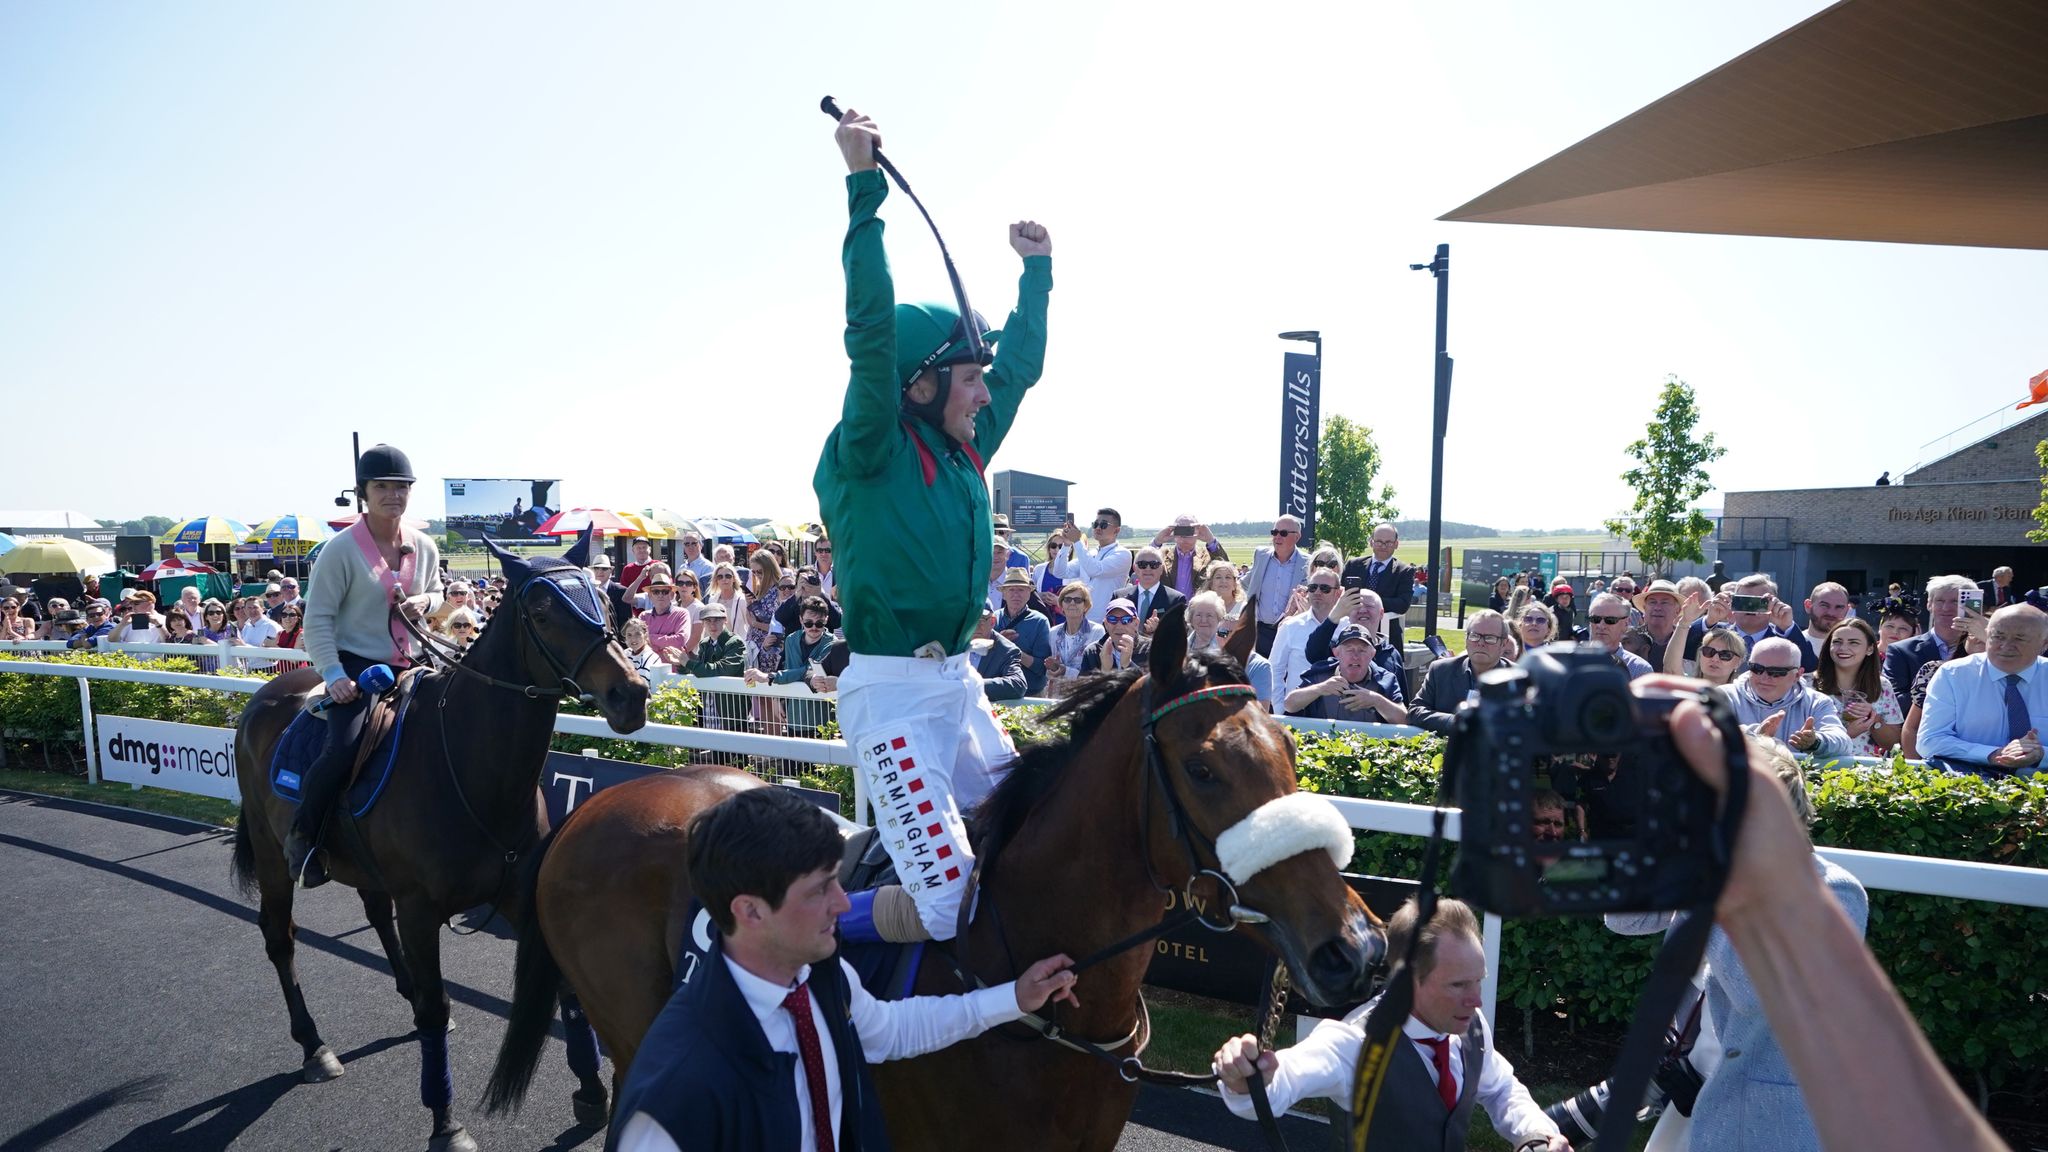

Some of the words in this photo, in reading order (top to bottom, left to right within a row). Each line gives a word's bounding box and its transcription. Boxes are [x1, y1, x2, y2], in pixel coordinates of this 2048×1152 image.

[1888, 508, 1912, 521] The
[1914, 508, 1941, 524] Aga
[1946, 506, 1986, 521] Khan
[1992, 505, 2031, 520] Stan
[863, 750, 920, 893] CAMERAS
[872, 742, 943, 889] BERMINGHAM
